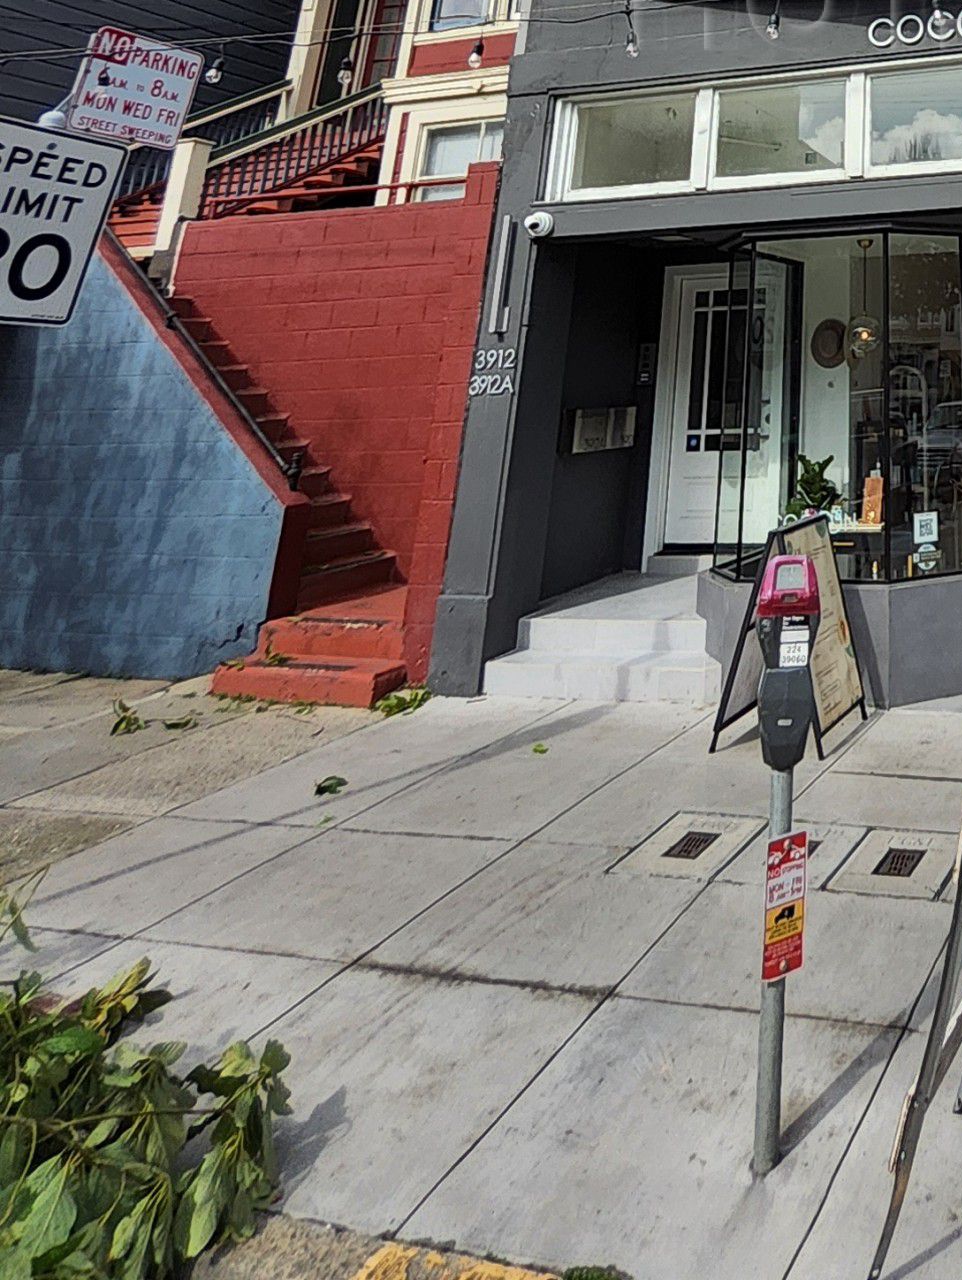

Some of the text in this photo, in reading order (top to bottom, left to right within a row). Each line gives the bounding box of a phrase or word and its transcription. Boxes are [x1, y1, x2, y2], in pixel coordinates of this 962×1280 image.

[98, 31, 199, 81] NO PARKING
[82, 90, 180, 128] MON WED FRI
[77, 116, 173, 144] STREET SWEEPING
[0, 142, 108, 188] PEED
[474, 347, 517, 371] 3912
[468, 374, 514, 397] 3912A
